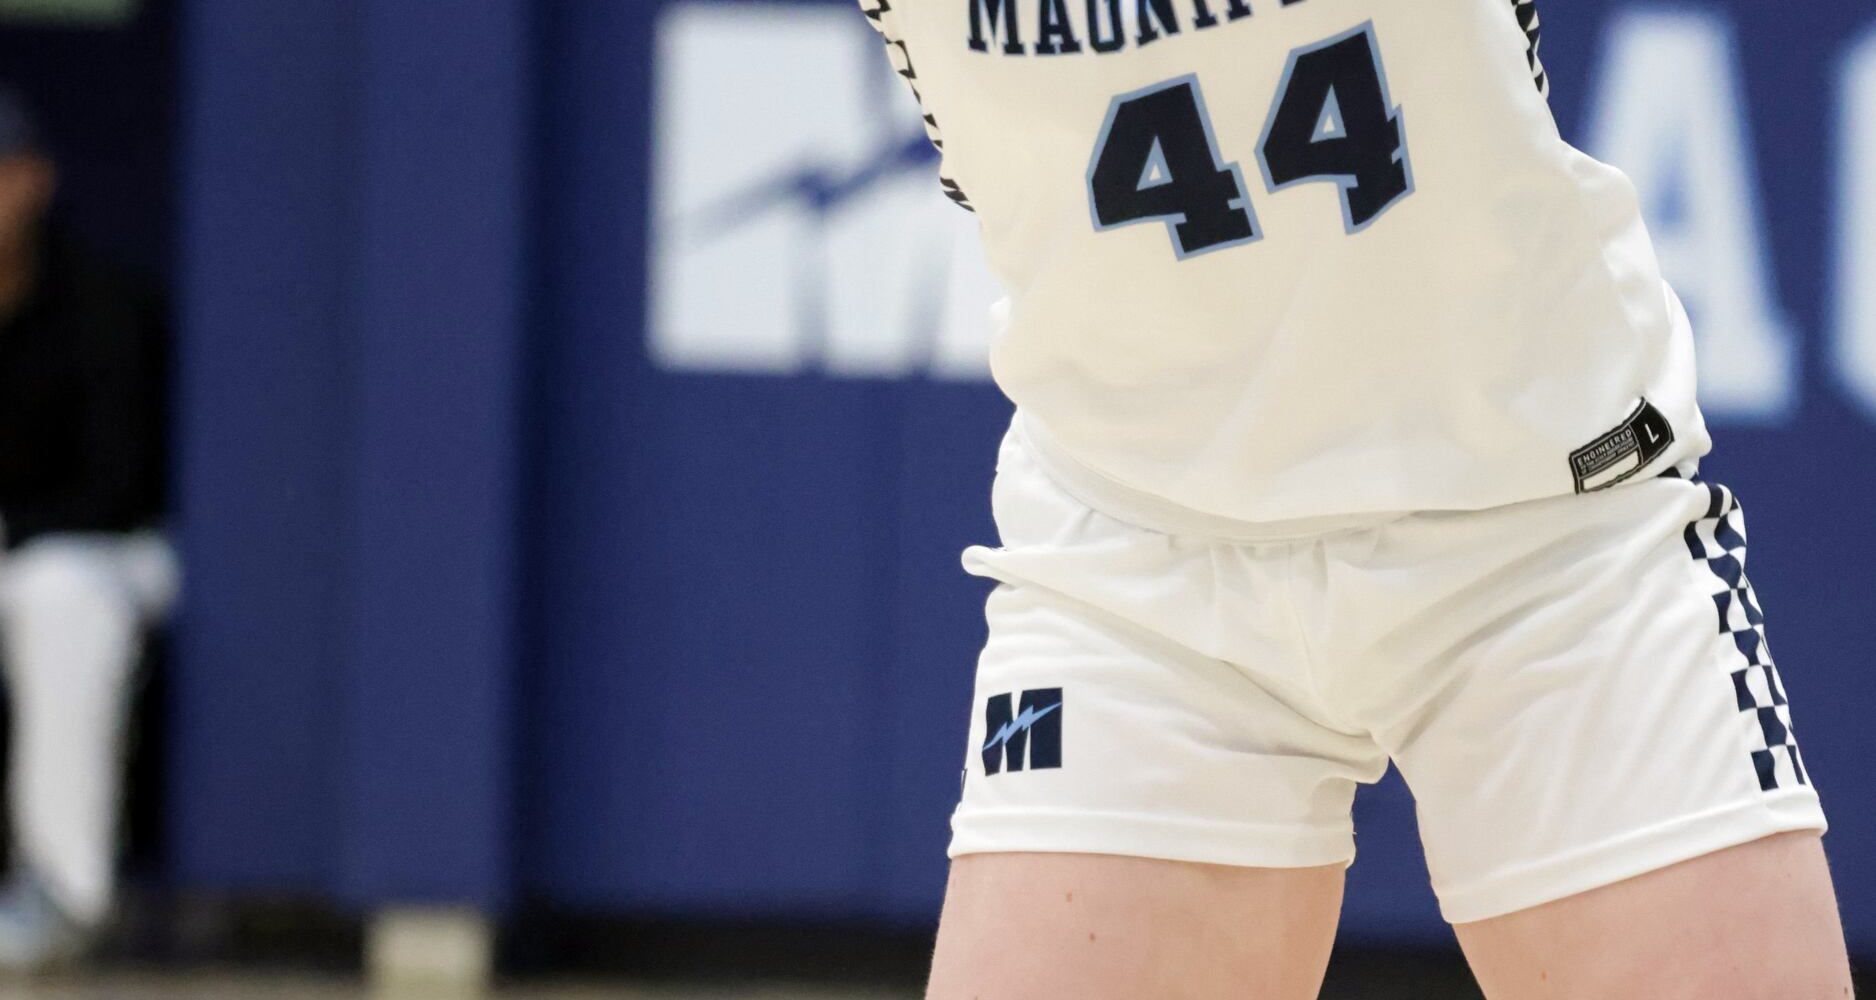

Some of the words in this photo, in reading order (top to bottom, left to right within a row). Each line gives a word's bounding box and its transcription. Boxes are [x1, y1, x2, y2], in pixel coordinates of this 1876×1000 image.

[1086, 18, 1416, 261] 44
[1577, 428, 1633, 465] ENGINEERED
[1644, 423, 1660, 444] L
